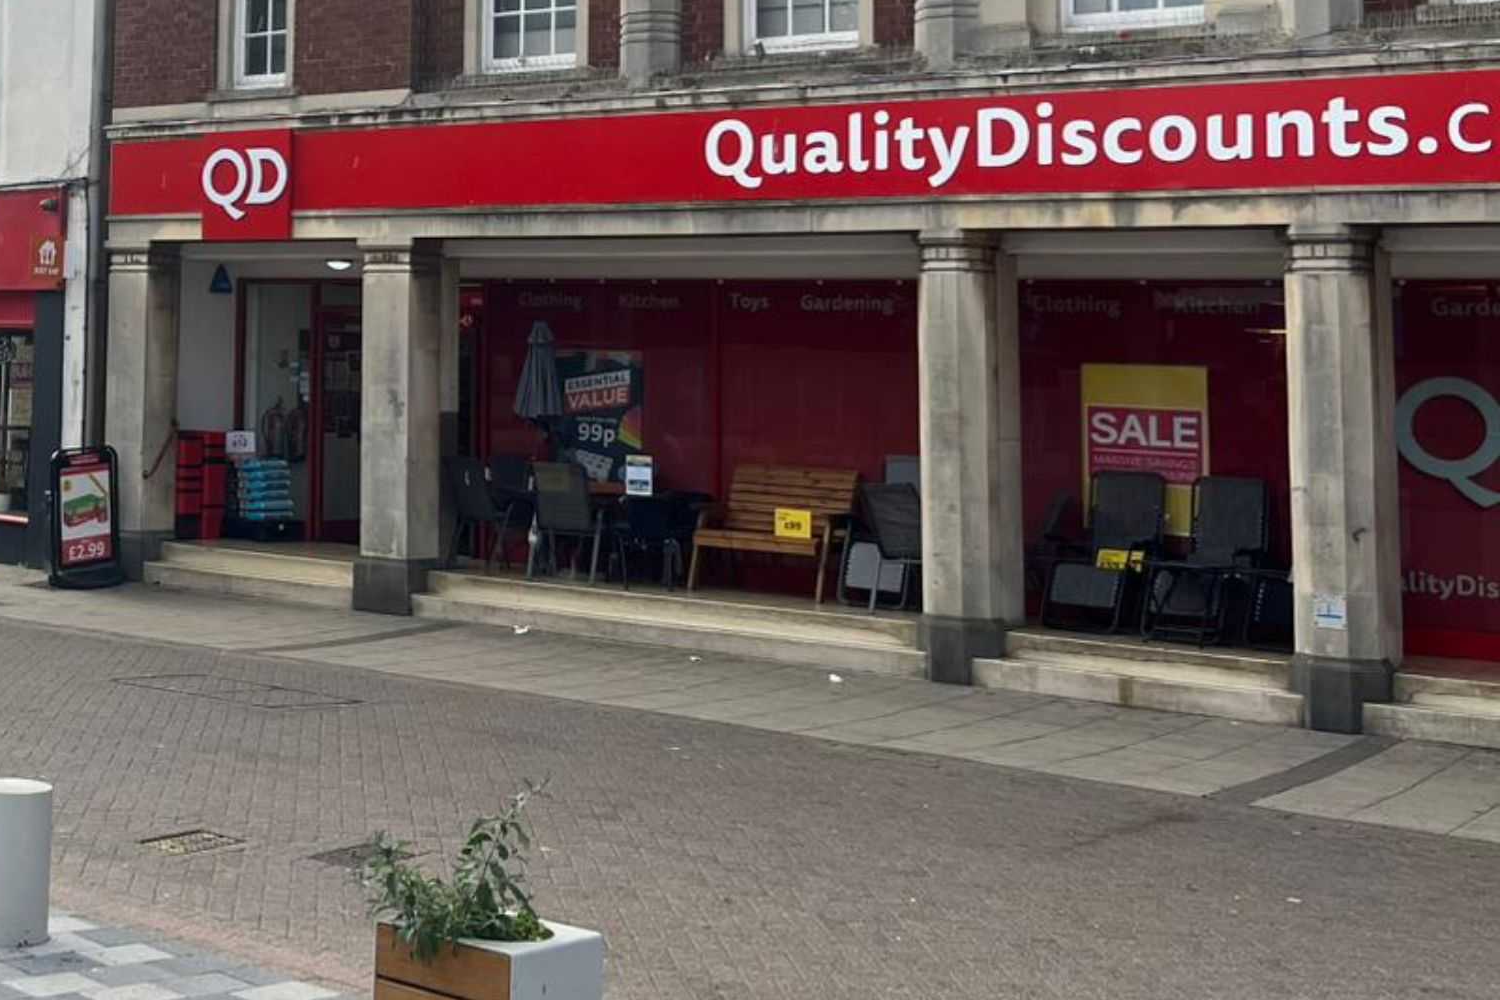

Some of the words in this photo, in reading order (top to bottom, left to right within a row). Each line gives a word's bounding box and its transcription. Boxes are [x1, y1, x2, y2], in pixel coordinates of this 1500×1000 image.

[202, 148, 288, 220] QD
[729, 294, 769, 312] Toys
[800, 293, 893, 315] Gardening
[1034, 295, 1122, 319] Clothing
[567, 373, 628, 390] ESSENTIAL
[568, 387, 629, 409] VALUE
[577, 422, 616, 448] 99p
[1091, 412, 1199, 449] SALE
[69, 541, 105, 560] £2.99
